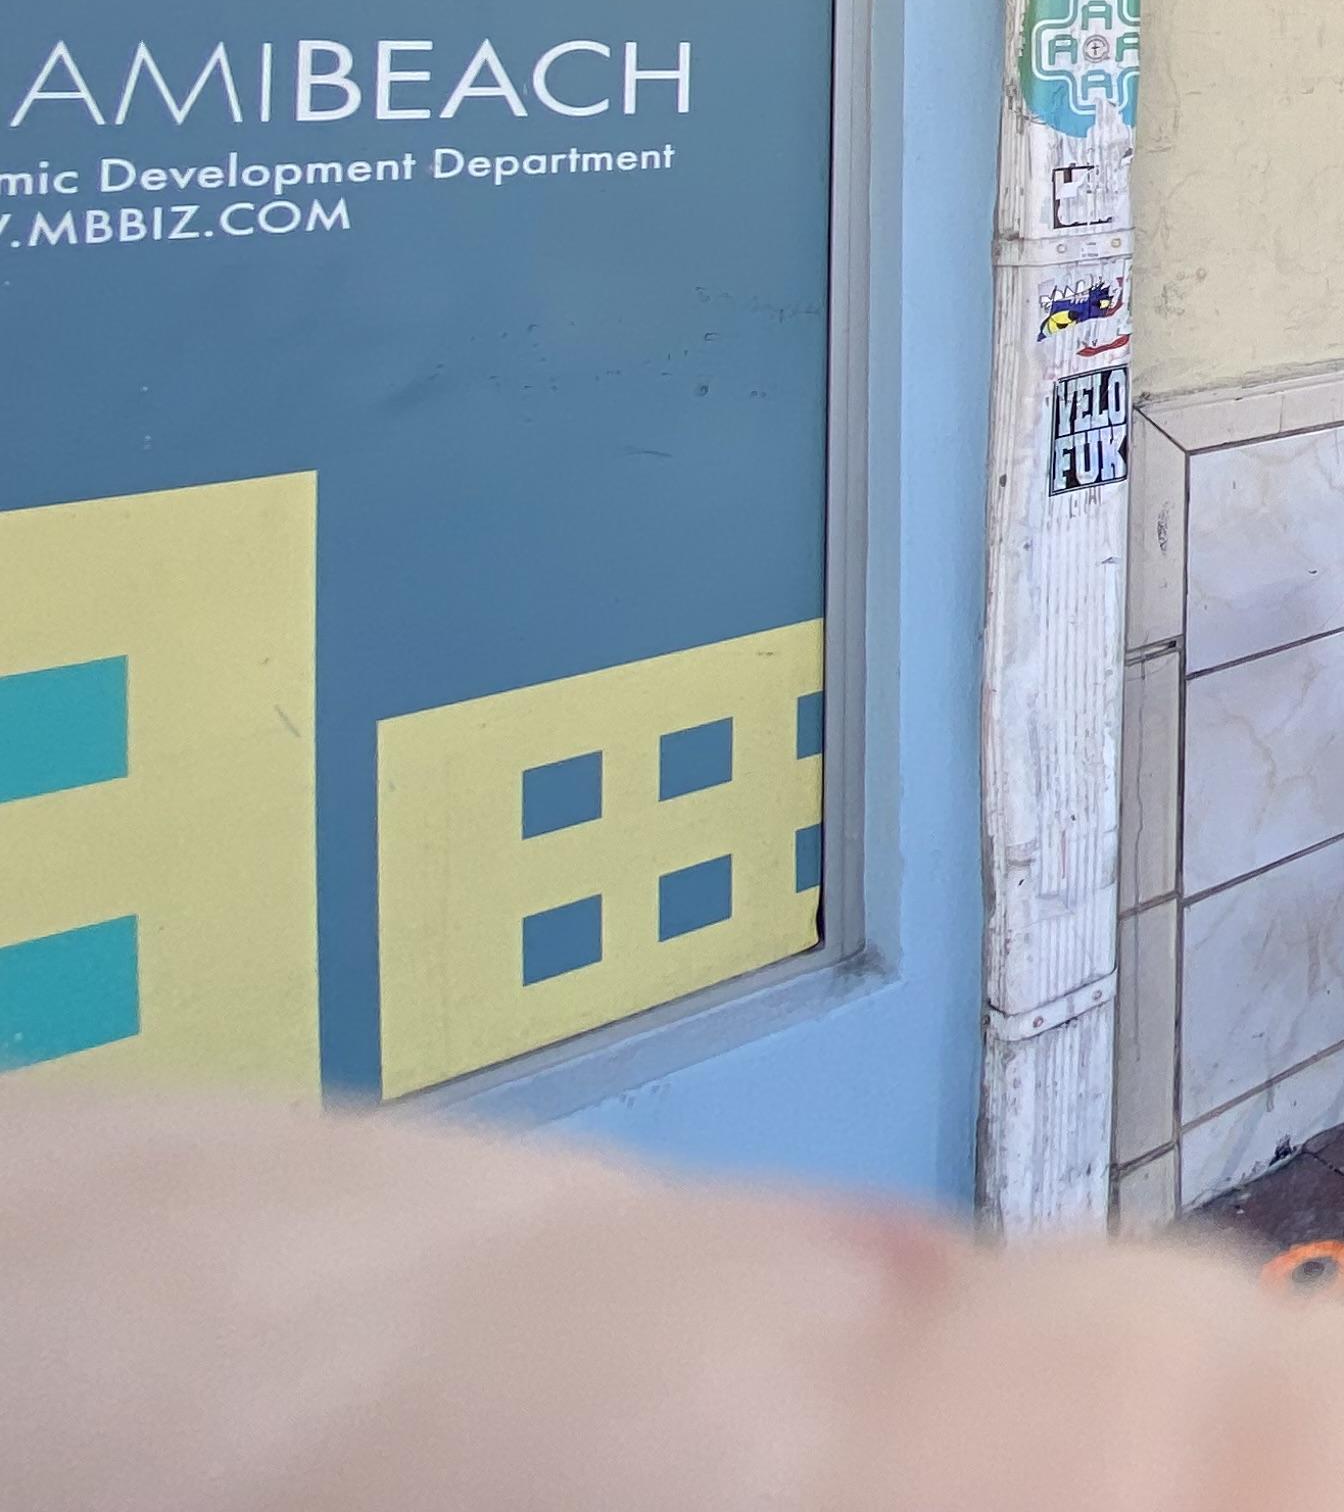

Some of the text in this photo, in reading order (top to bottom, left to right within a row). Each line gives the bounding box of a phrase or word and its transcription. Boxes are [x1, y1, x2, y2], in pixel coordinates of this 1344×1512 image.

[100, 152, 415, 195] Development
[433, 144, 675, 185] Department
[1053, 424, 1127, 489] FUK
